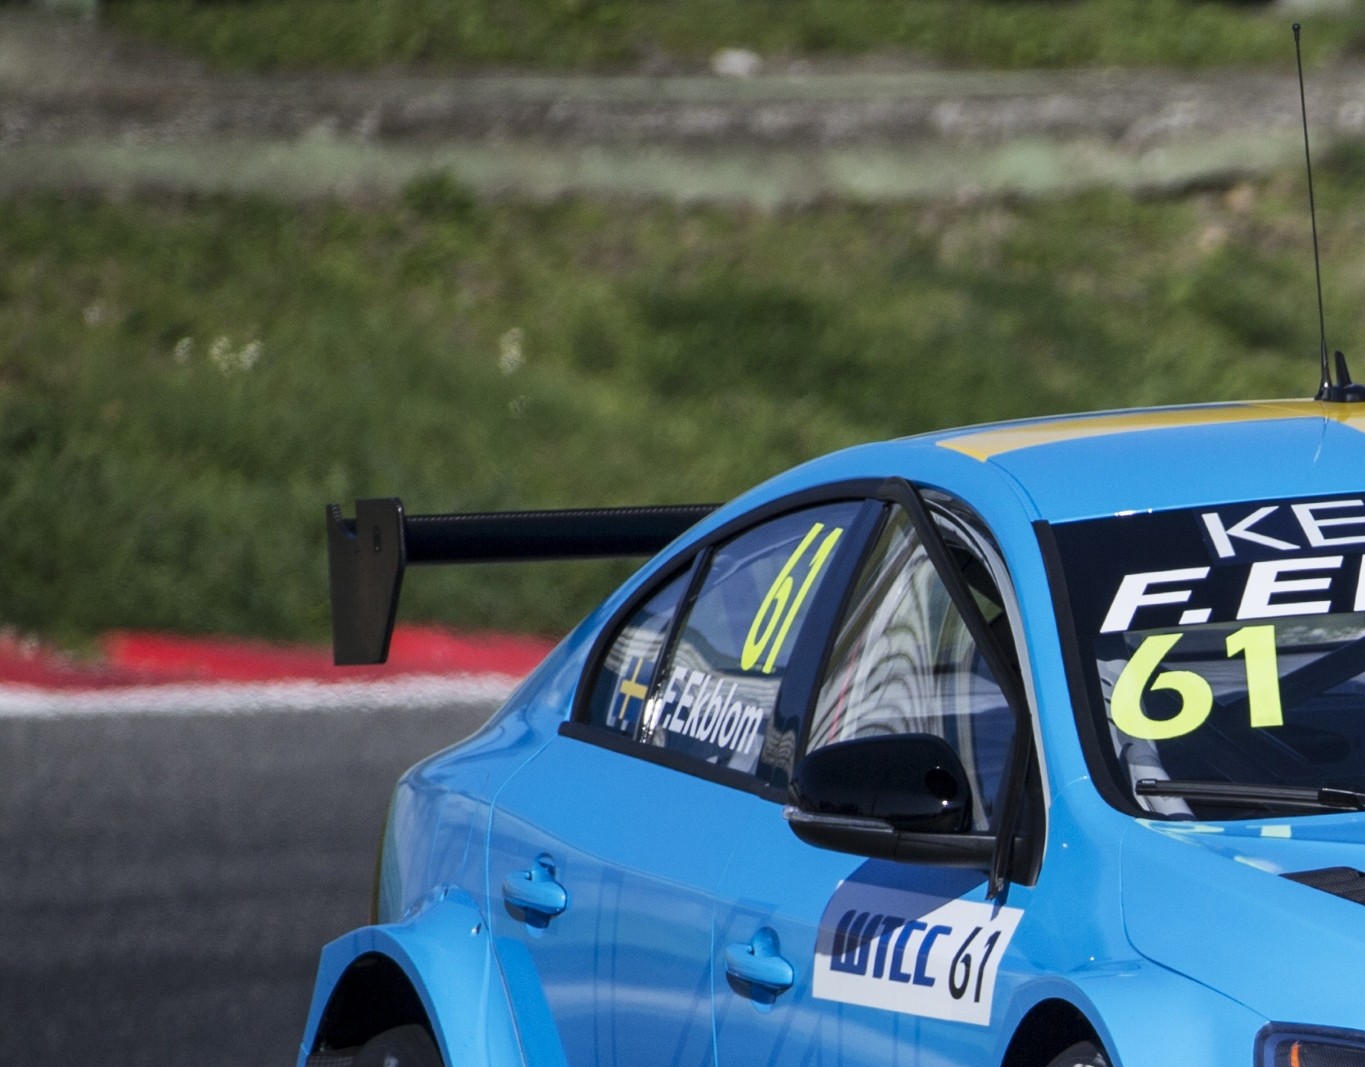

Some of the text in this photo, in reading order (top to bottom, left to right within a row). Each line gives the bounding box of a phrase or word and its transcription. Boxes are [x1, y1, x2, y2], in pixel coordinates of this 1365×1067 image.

[740, 522, 844, 674] 61
[1109, 624, 1284, 740] 61
[829, 909, 1002, 1004] WTCC 61
